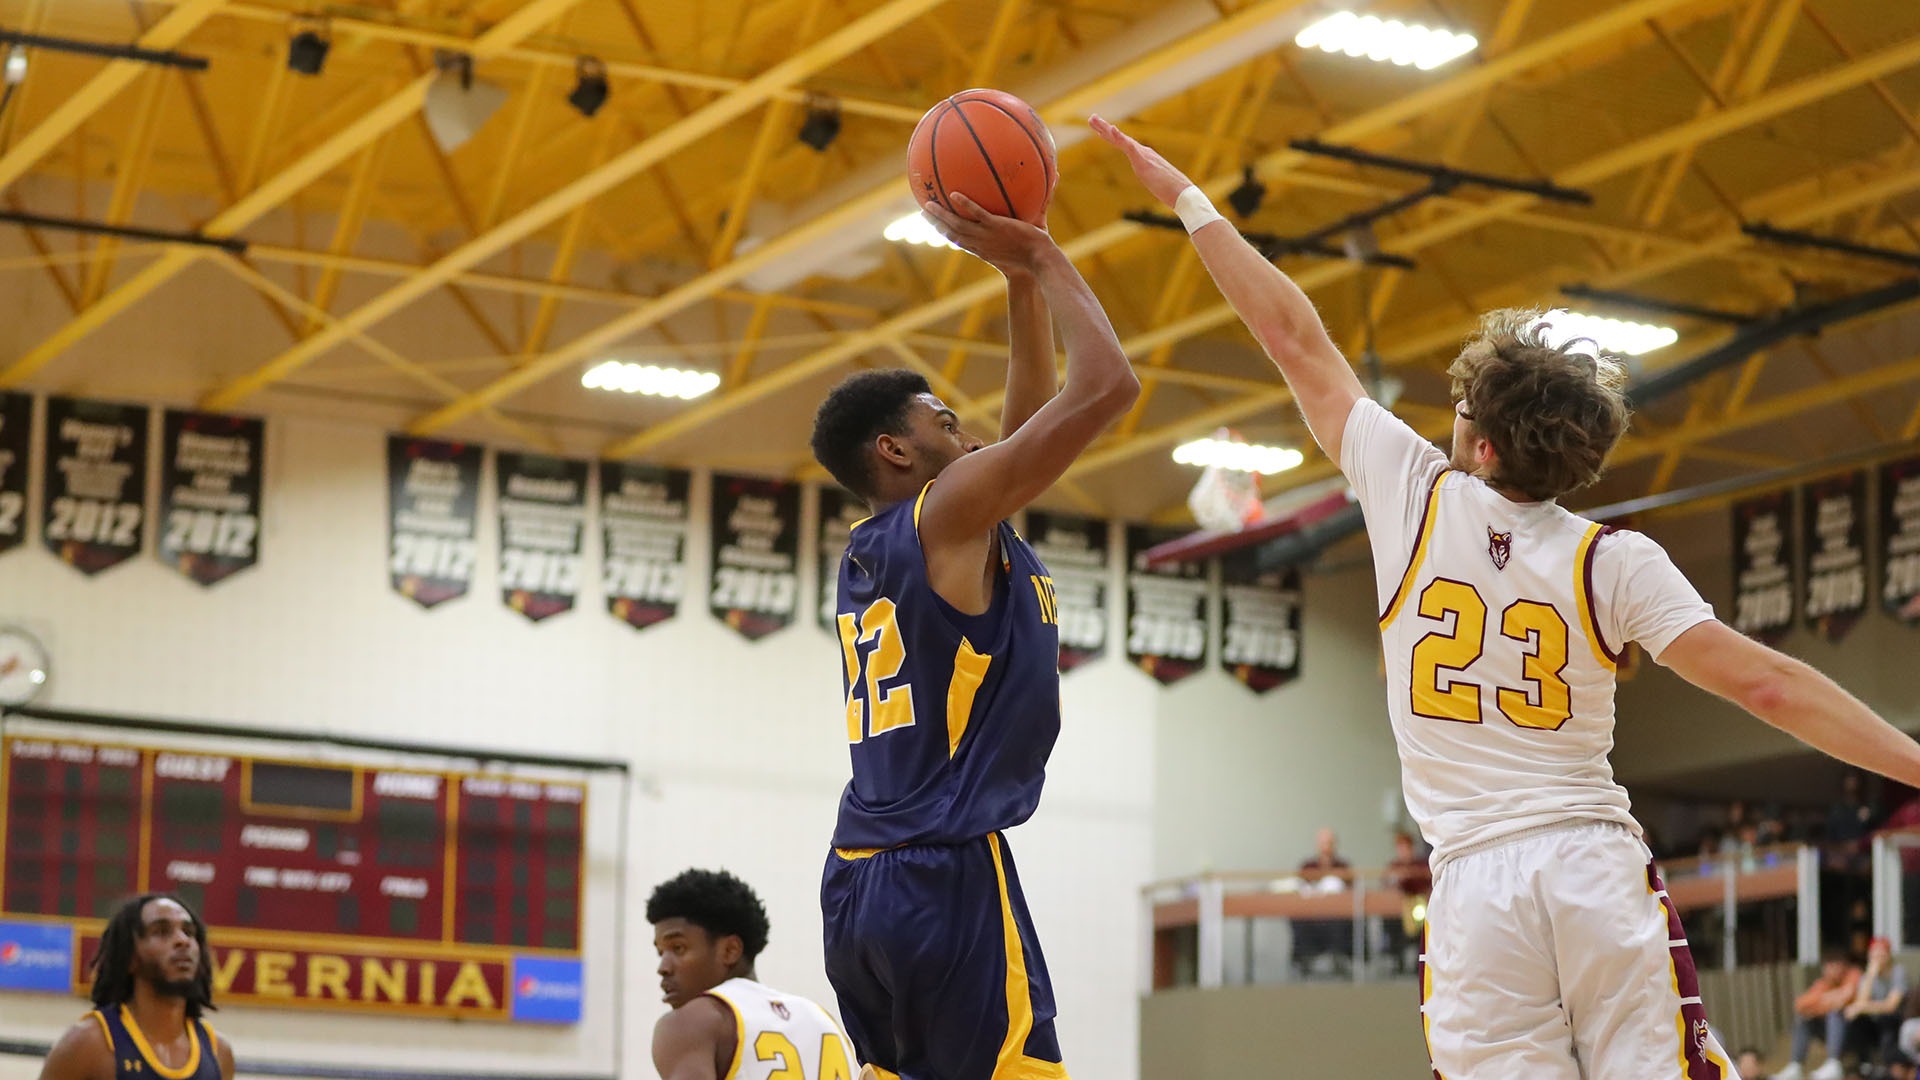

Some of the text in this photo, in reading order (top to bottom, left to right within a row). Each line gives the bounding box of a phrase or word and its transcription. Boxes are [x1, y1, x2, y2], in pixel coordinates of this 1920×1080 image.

[50, 498, 142, 545] 2012
[166, 509, 257, 557] 2012
[392, 533, 478, 581] 2012
[1409, 576, 1574, 732] 23
[155, 752, 233, 783] GUEST
[373, 772, 442, 801] HOME
[207, 947, 495, 1010] VERNIA
